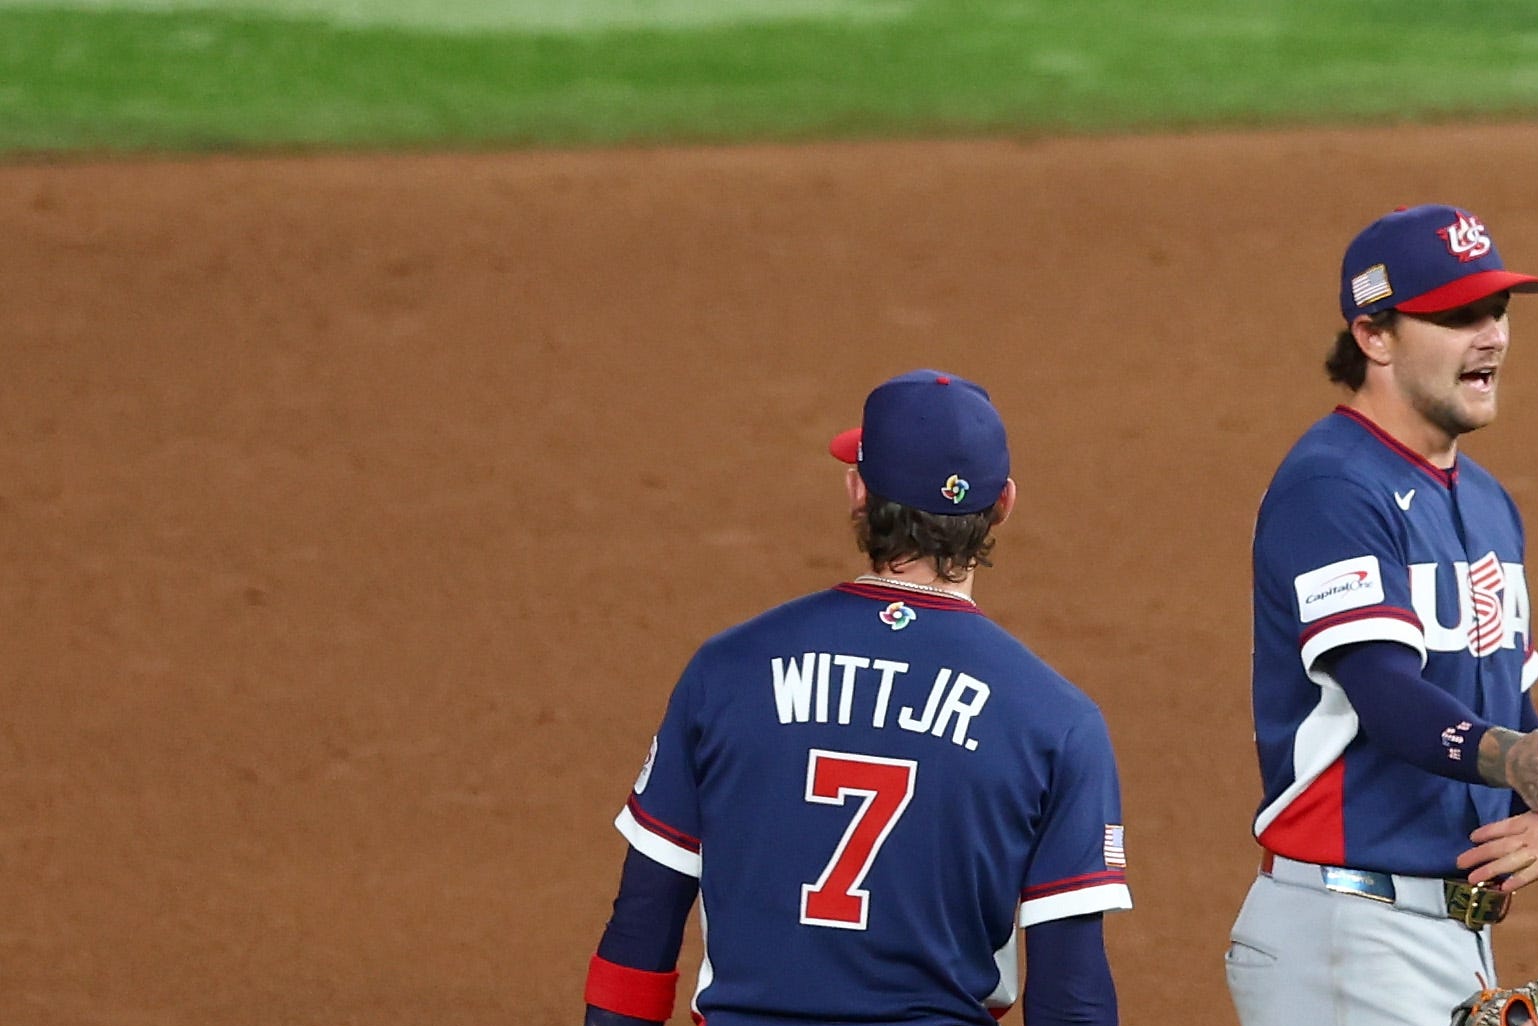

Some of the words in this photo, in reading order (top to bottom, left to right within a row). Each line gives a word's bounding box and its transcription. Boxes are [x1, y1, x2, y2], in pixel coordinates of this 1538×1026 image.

[1407, 550, 1531, 658] USA
[771, 652, 909, 729] WITT
[898, 668, 991, 751] JR.
[799, 748, 918, 931] 7
